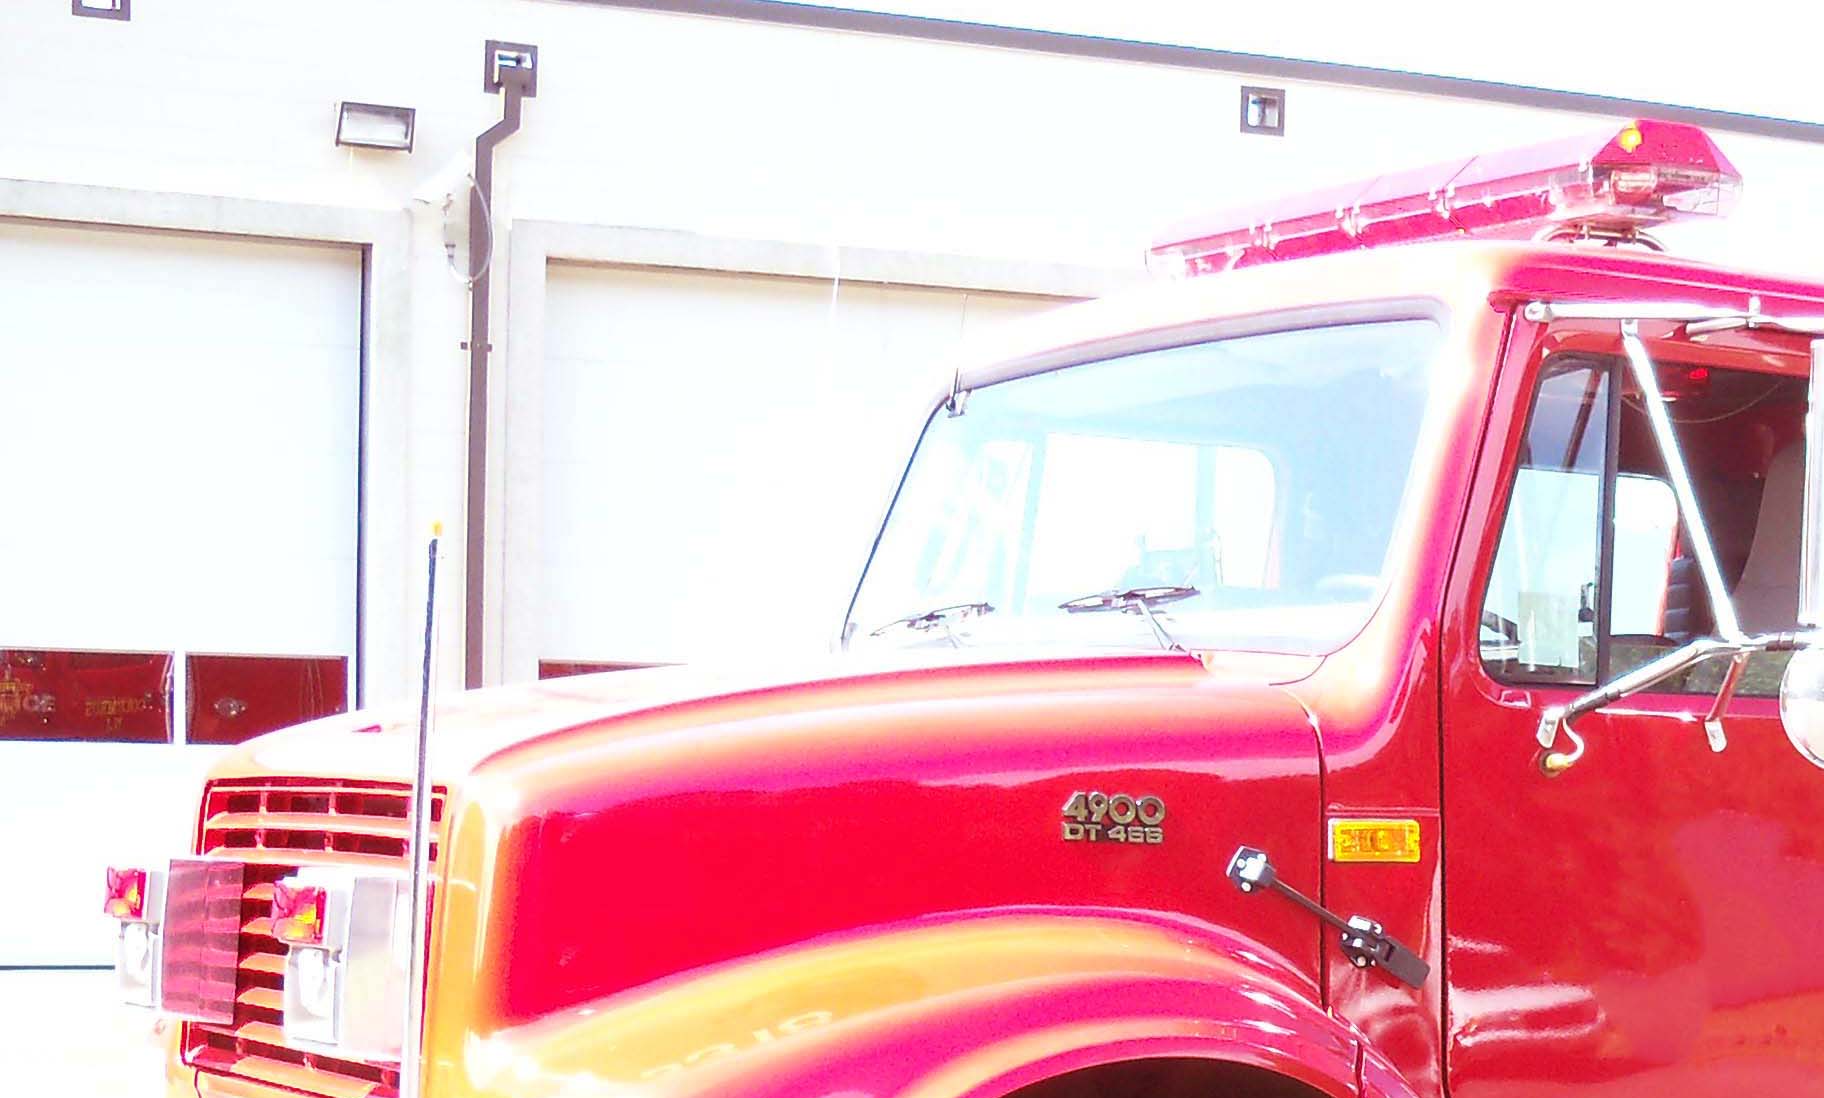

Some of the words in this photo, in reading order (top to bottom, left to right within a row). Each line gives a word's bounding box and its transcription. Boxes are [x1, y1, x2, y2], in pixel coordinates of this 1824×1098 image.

[1062, 790, 1166, 826] 4900
[1062, 821, 1102, 842] DT
[1107, 825, 1164, 844] 466
